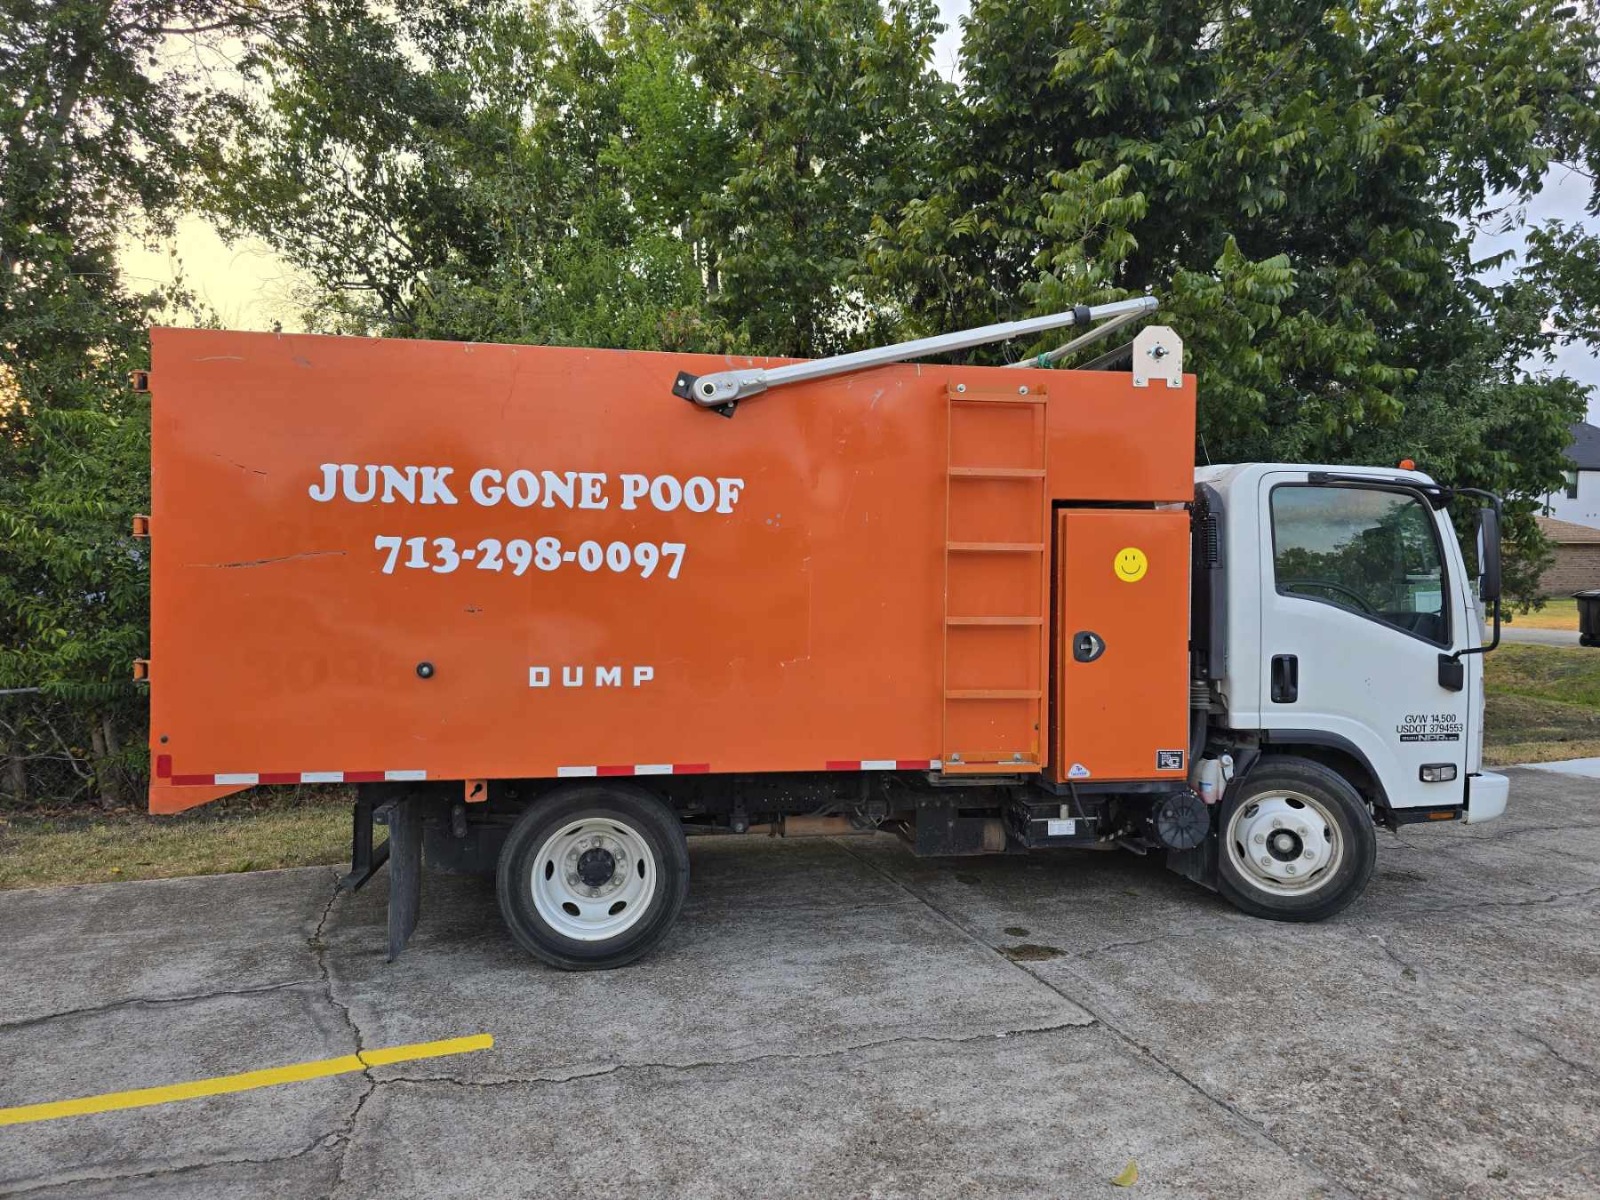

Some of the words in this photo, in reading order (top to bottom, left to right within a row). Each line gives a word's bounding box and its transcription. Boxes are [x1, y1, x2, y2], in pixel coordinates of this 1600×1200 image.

[308, 463, 458, 505] JUNK
[469, 467, 609, 510] GONE
[620, 473, 745, 514] POOF
[374, 534, 687, 580] 713-298-0097
[528, 665, 654, 688] DUMP
[1396, 724, 1427, 733] USDOT
[1429, 723, 1463, 733] 3794553
[1404, 714, 1428, 723] GVW
[1431, 714, 1456, 724] 14,500
